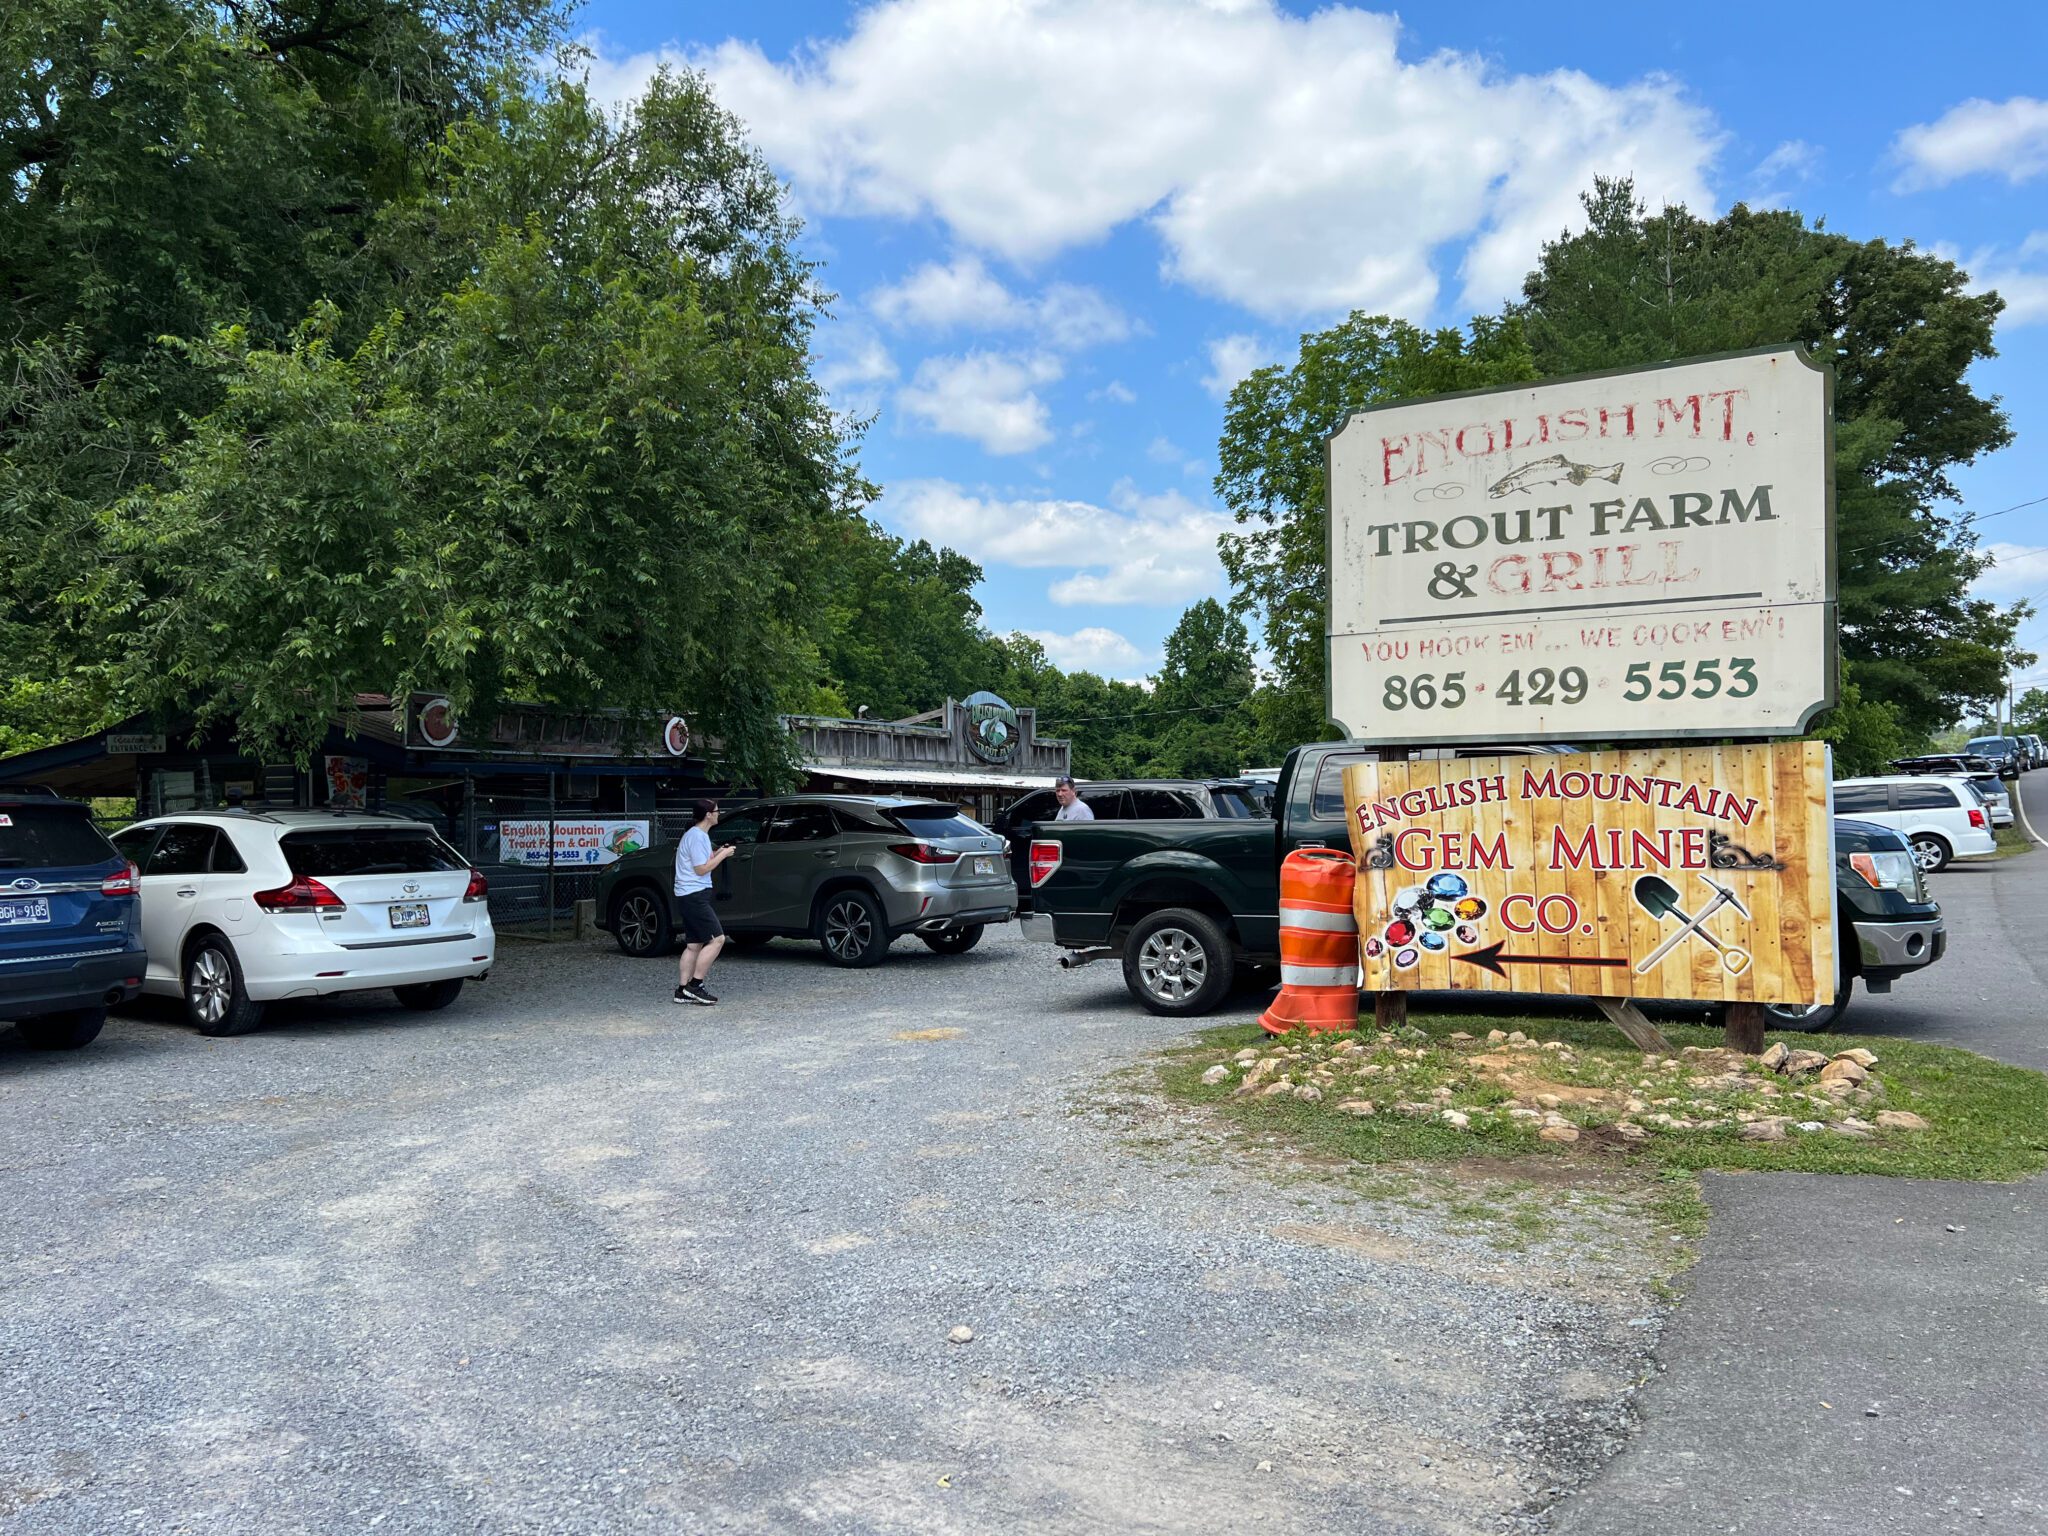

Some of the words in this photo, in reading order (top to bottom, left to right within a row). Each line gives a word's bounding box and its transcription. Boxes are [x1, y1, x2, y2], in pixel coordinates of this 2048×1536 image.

[1379, 402, 1640, 486] ENGLISH
[1653, 388, 1758, 449] MT.
[1367, 504, 1574, 557] TROUT
[1590, 484, 1777, 538] FARM
[1427, 561, 1479, 600] &
[1486, 540, 1701, 596] GRILL
[1361, 640, 1409, 662] YOU
[1419, 635, 1490, 659] HOOK
[1580, 626, 1623, 648] WE
[1632, 621, 1712, 646] COOK
[1382, 671, 1467, 711] 865
[1495, 666, 1589, 707] 429
[1622, 657, 1759, 702] 5553
[976, 741, 998, 757] TROUT
[1355, 774, 1509, 835] ENGLISH
[1519, 767, 1760, 827] MOUNTAIN
[501, 824, 546, 837] English
[508, 838, 536, 849] Trout
[568, 838, 576, 848] &
[577, 837, 599, 848] Grill
[1394, 826, 1515, 872] GEM
[1551, 824, 1708, 871] MINE
[526, 850, 580, 860] 865-49-5553
[23, 904, 47, 917] 9185
[1498, 893, 1595, 936] CO.
